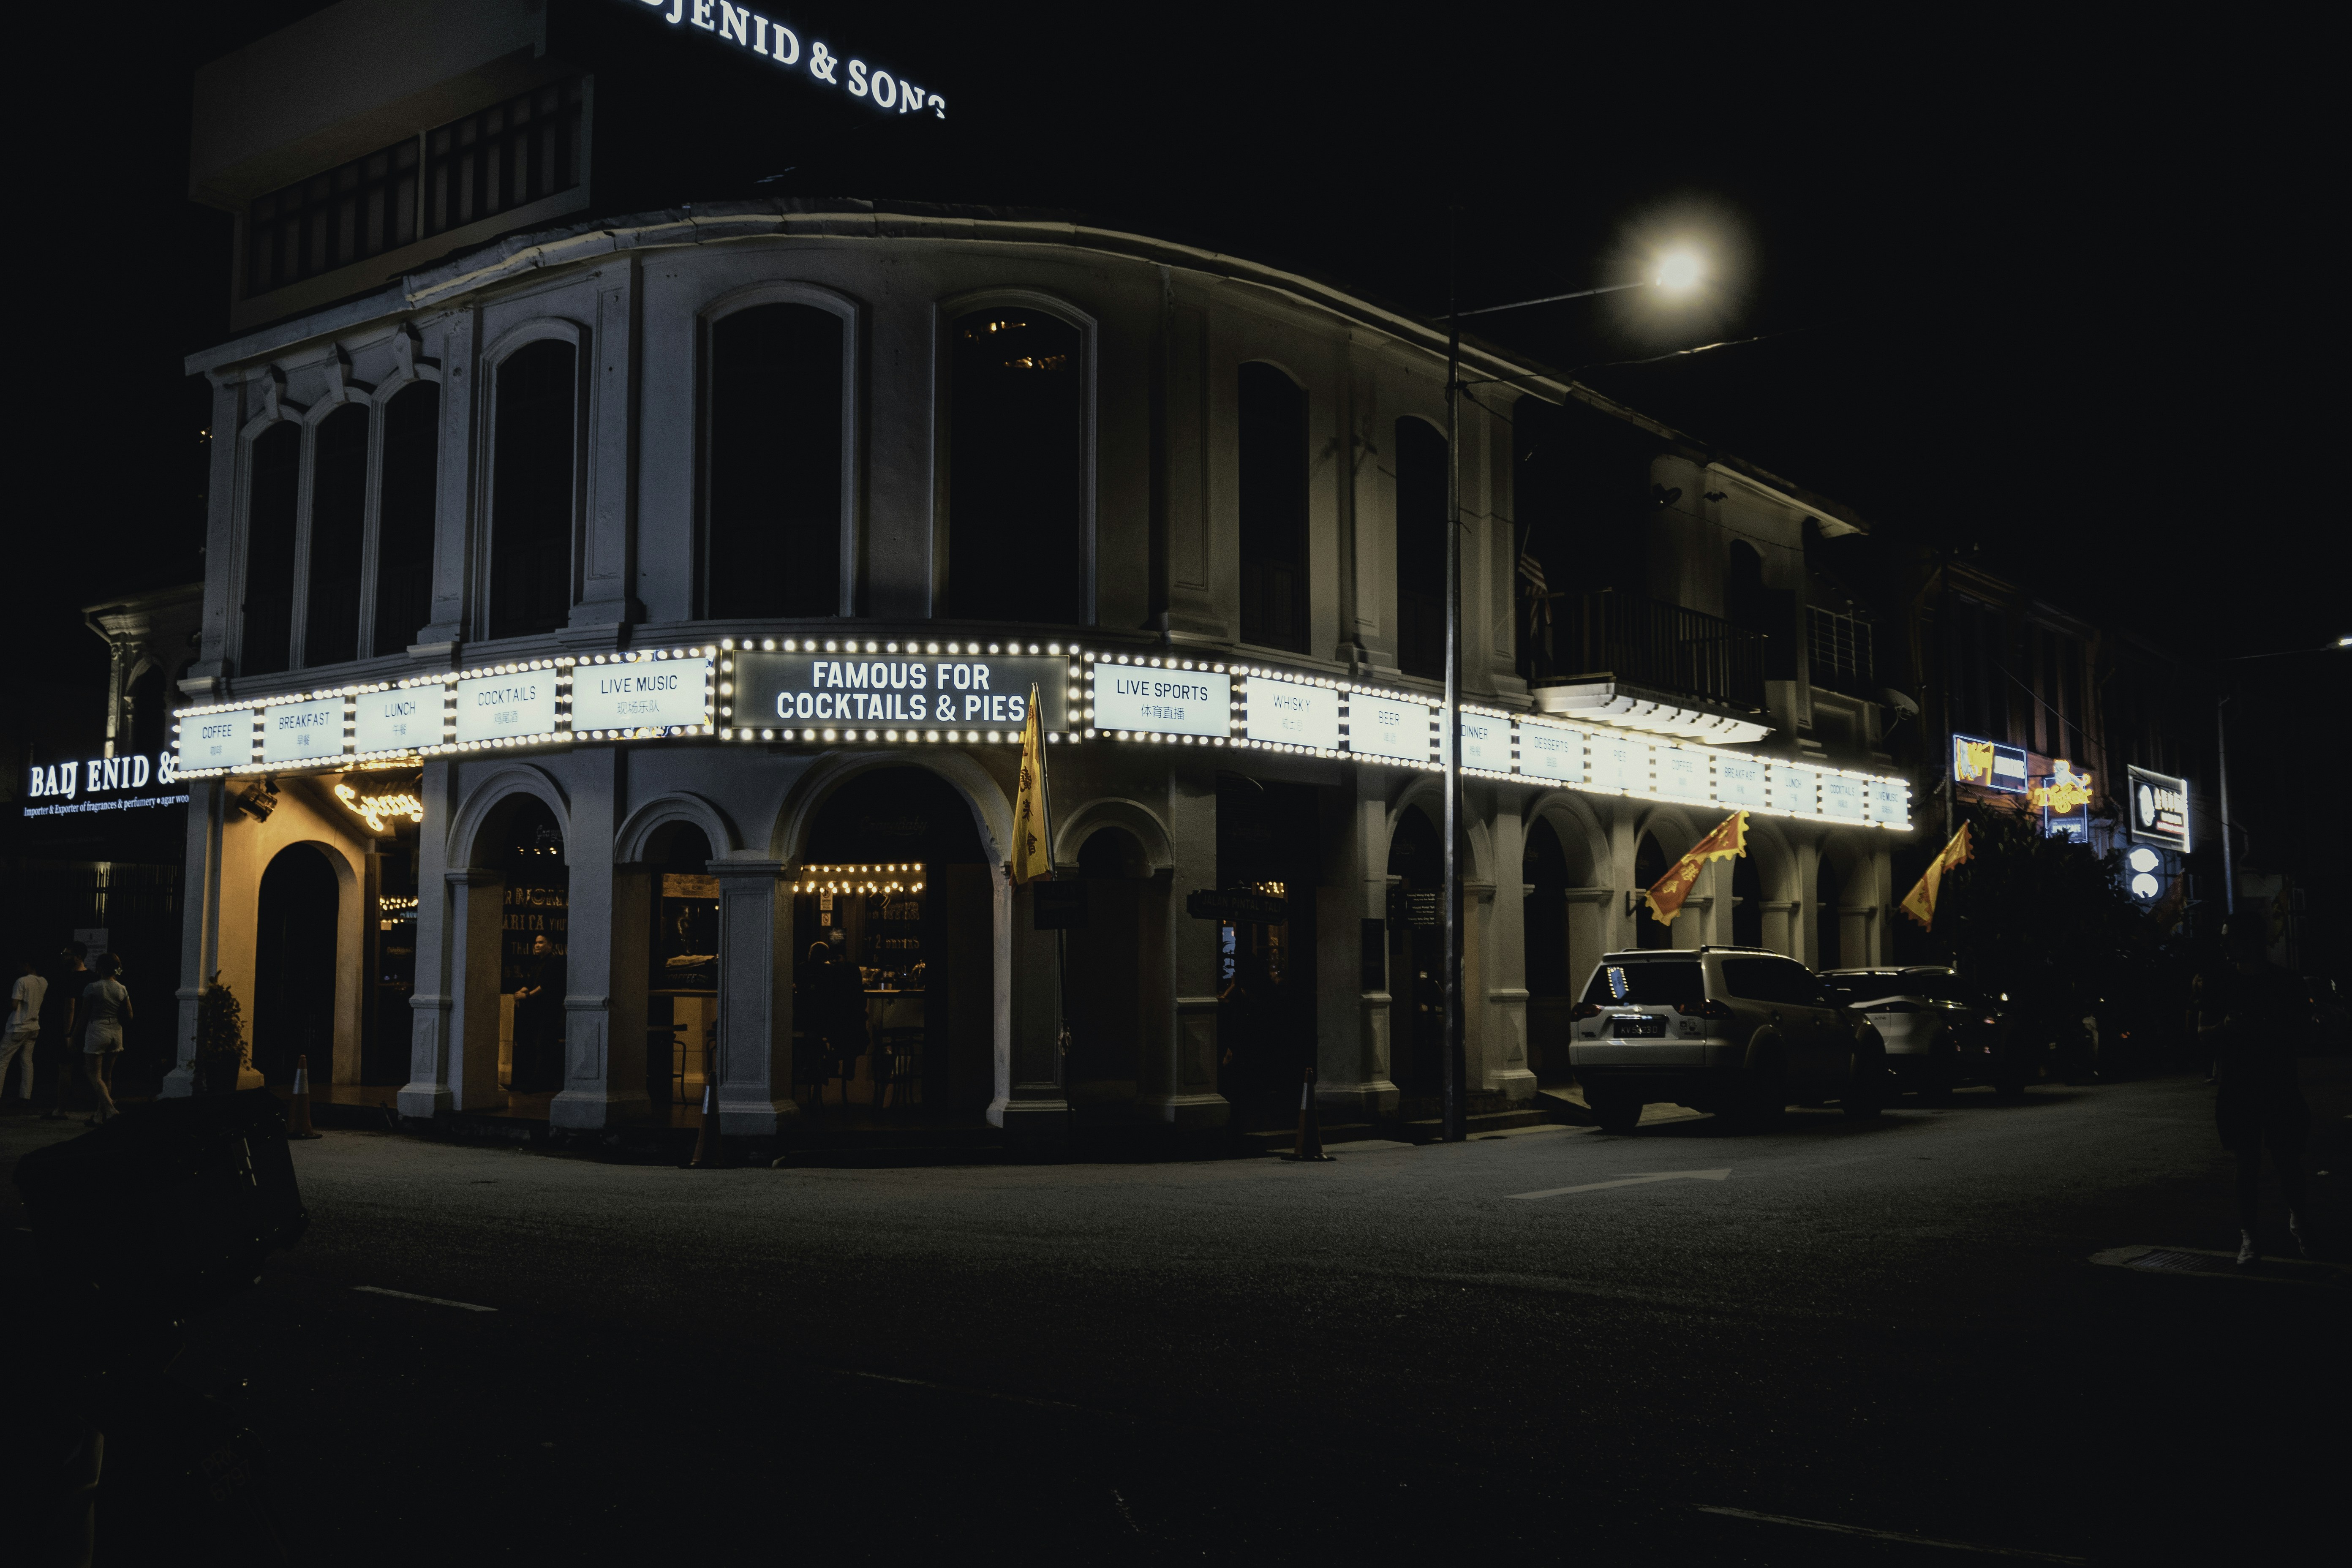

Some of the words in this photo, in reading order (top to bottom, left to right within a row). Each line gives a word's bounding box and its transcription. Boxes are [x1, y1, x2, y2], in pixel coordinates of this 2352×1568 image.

[640, 0, 799, 65] JENID
[809, 41, 838, 85] &
[602, 678, 632, 694] LIVE
[637, 675, 678, 691] MUSIC
[814, 662, 927, 689] FAMOUS
[938, 663, 990, 690] FOR
[478, 685, 536, 706] COCKTAILS
[1117, 679, 1149, 696] LIVE
[1154, 682, 1208, 701] SPORTS
[385, 701, 416, 717] LUNCH
[617, 700, 659, 714] 现场乐队
[777, 692, 927, 720] COCKTAILS
[936, 694, 956, 721] &
[965, 695, 1025, 721] PIES
[1141, 704, 1184, 720] 体育直播
[1273, 694, 1311, 713] WHISKY
[279, 712, 330, 730] BREAKFAST
[1379, 711, 1400, 726] BEER
[202, 724, 232, 739] COFFEE
[1461, 724, 1488, 740] DINNER
[1535, 736, 1568, 753] DESSERTS
[87, 755, 149, 792] ENID
[158, 751, 176, 785] &
[1672, 759, 1693, 773] COFFEE
[1725, 767, 1756, 781] BREAKFAST
[1786, 777, 1802, 788] LUNCH
[1830, 784, 1854, 796] COCKTAILS
[24, 806, 49, 818] Importer
[49, 805, 54, 814] &
[54, 803, 79, 816] Exporter
[80, 801, 87, 812] of
[87, 800, 117, 814] fragrances
[117, 799, 123, 808] &
[123, 797, 156, 811] perfumery
[161, 797, 175, 806] agar
[1202, 895, 1228, 906] JALAN
[1232, 898, 1259, 911] PINTAL
[1264, 901, 1281, 913] TALI
